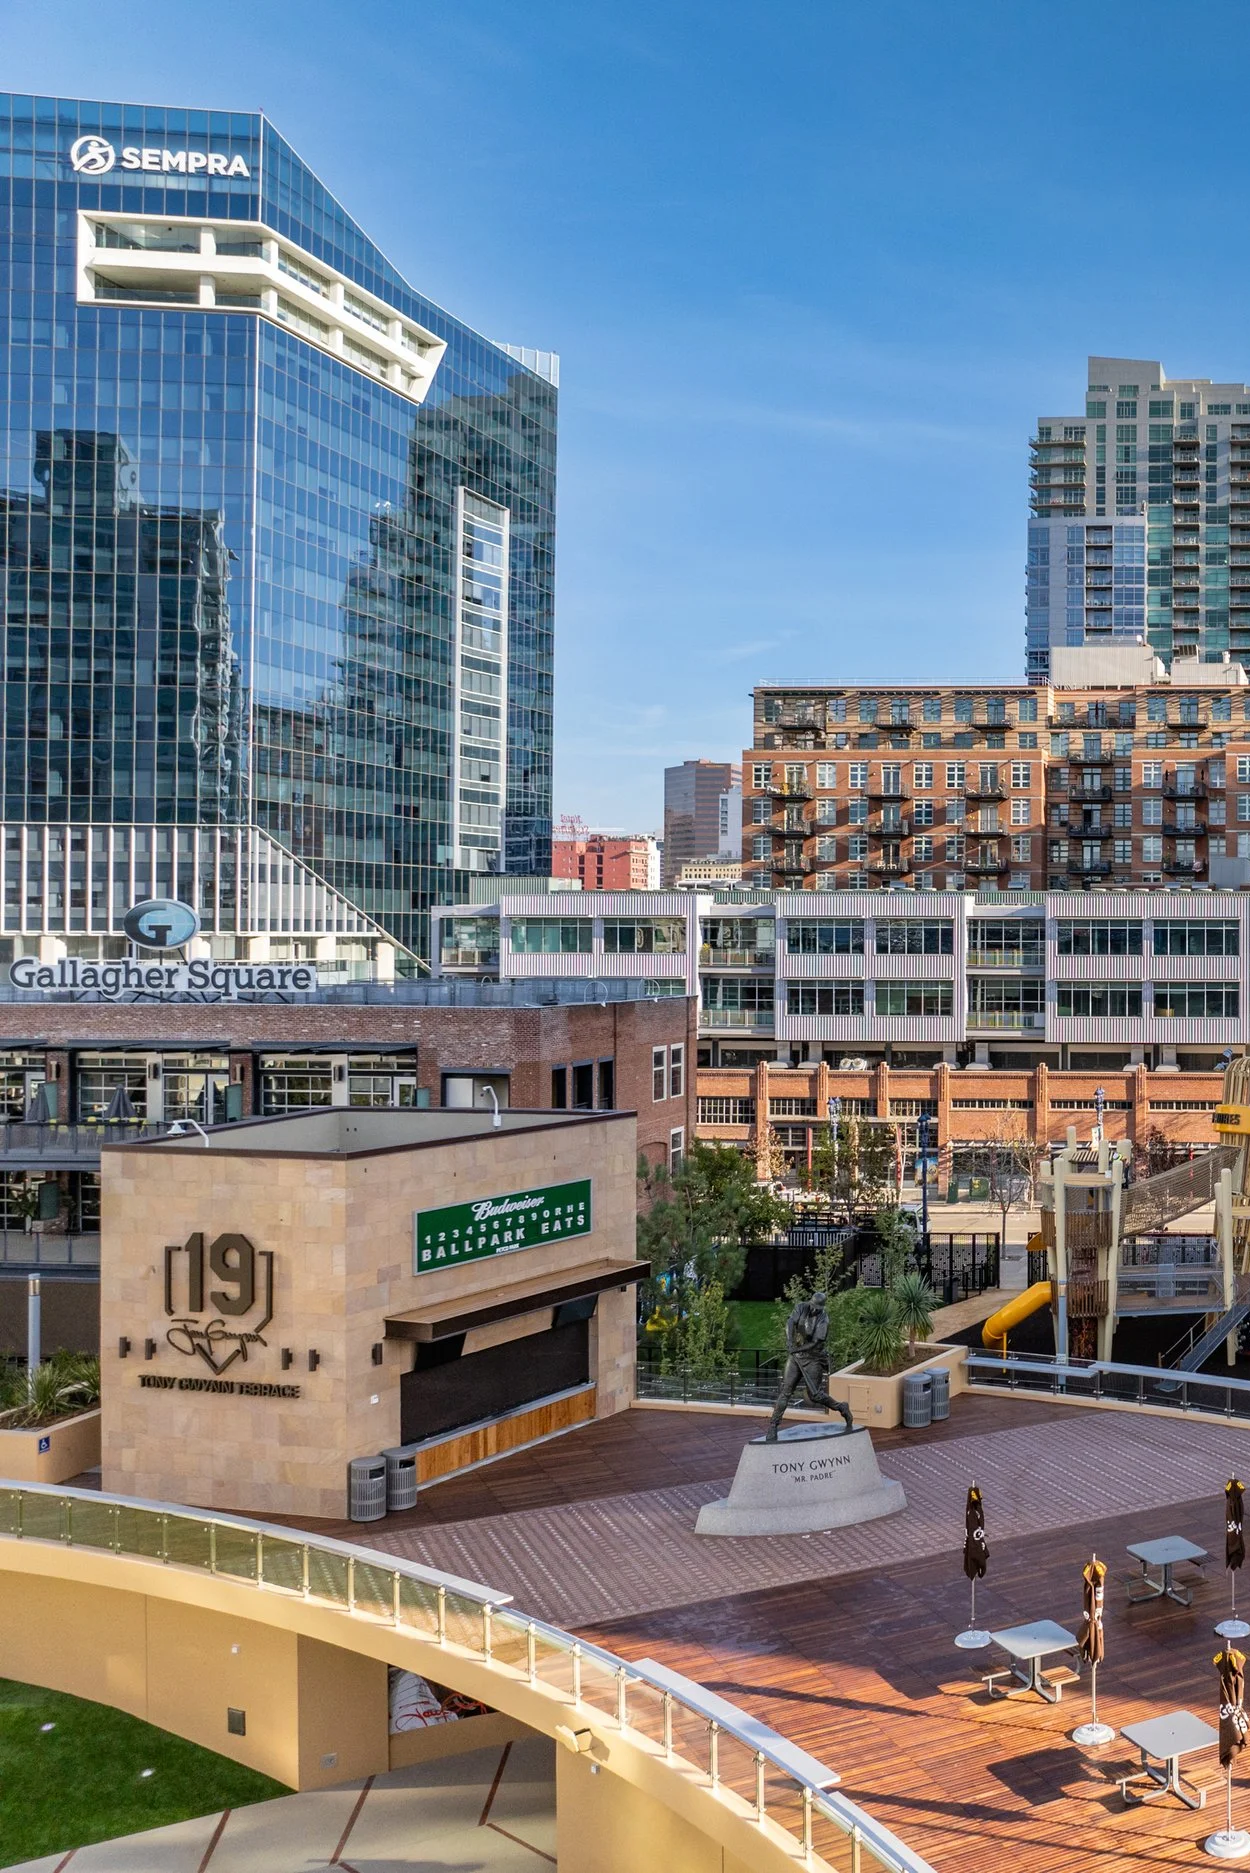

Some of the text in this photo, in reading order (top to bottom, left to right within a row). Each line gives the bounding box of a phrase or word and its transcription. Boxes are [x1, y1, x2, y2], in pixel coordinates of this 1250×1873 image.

[121, 147, 250, 177] SEMPRA
[10, 959, 312, 997] Gallagher Square
[425, 1236, 431, 1244] 1
[438, 1232, 445, 1241] 2
[452, 1229, 459, 1238] 3
[466, 1226, 473, 1235] 4
[480, 1224, 487, 1232] 5
[493, 1221, 500, 1229] 6
[506, 1218, 513, 1226] 7
[518, 1215, 525, 1223] 8
[531, 1212, 537, 1221] 9
[555, 1207, 562, 1215] R
[567, 1205, 574, 1213] H
[579, 1202, 585, 1210] E
[471, 1195, 545, 1221] Budweiser
[422, 1215, 585, 1262] BALLPARK EATS
[184, 1232, 256, 1316] 19
[138, 1375, 301, 1398] TONY GWYNN TERRACE
[772, 1455, 851, 1474] TONY GWYNN
